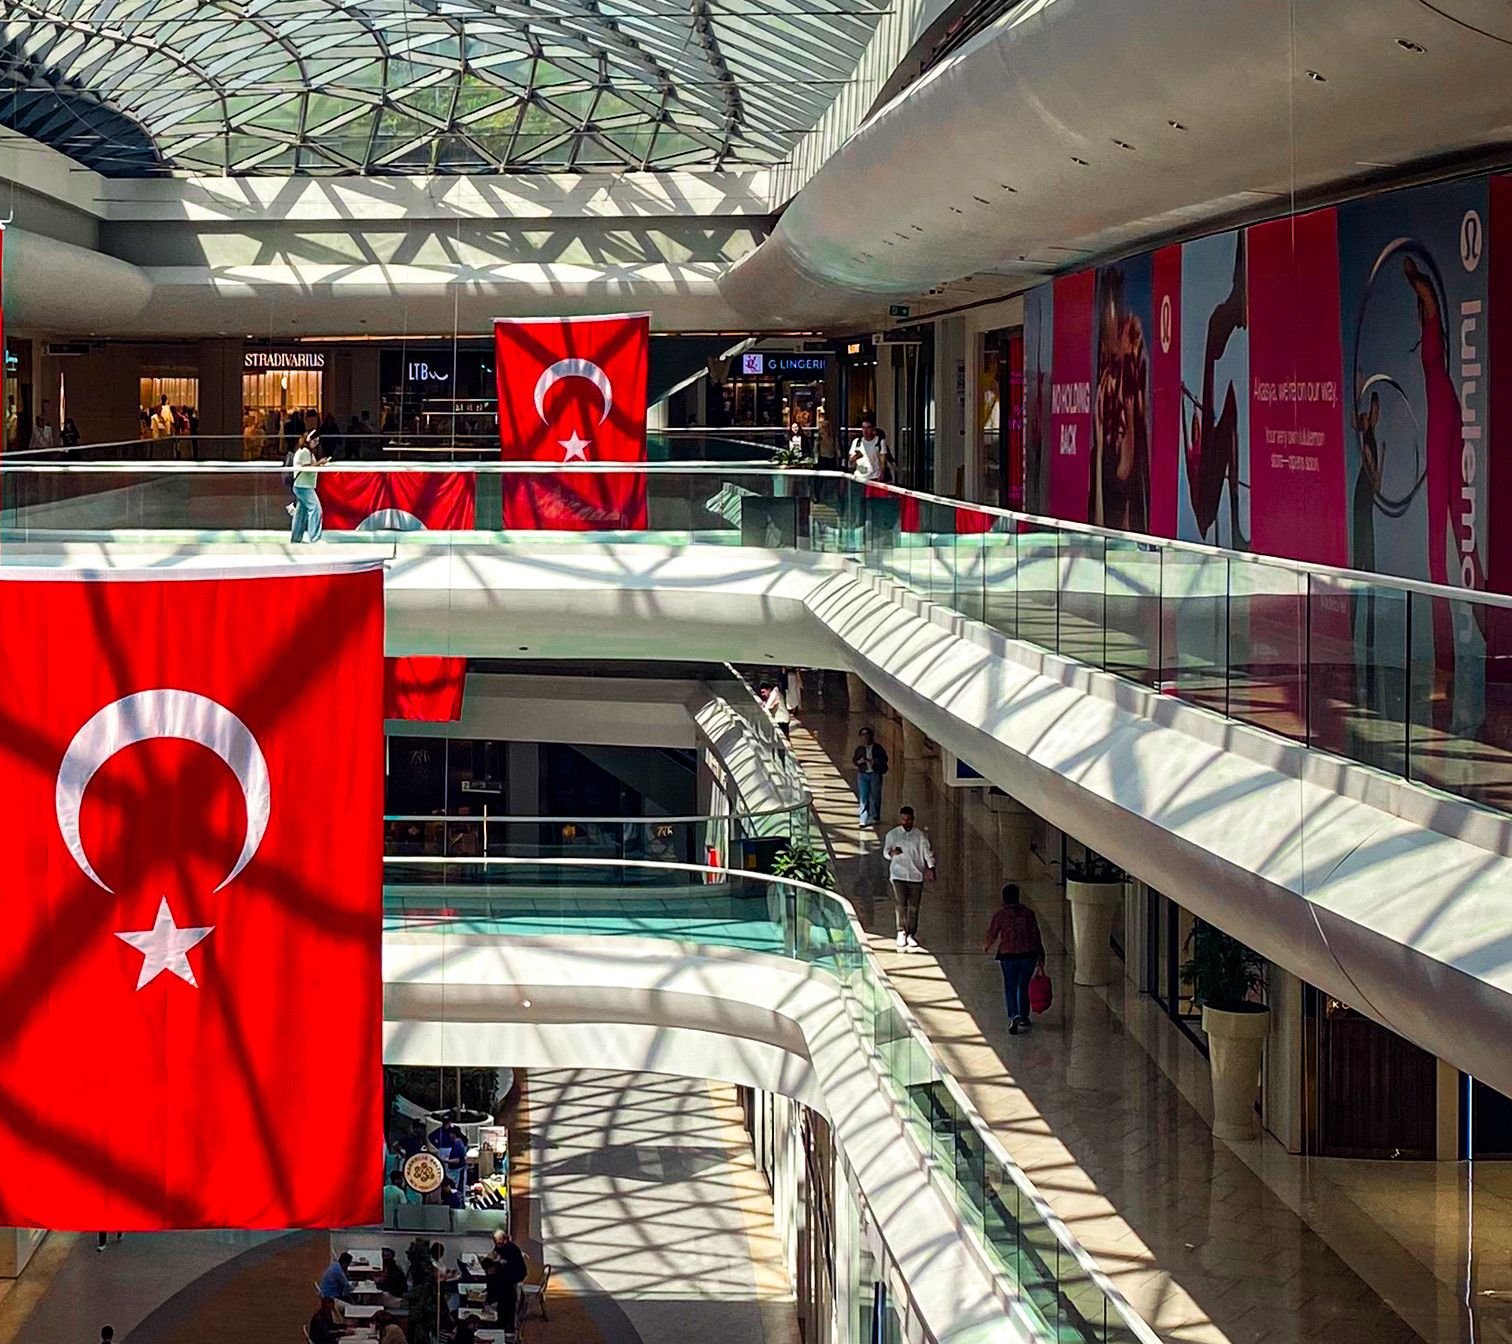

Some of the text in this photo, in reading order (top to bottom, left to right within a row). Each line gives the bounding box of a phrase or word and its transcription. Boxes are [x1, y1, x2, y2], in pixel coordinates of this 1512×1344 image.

[244, 352, 325, 368] STRADIVARIUS
[768, 359, 777, 369] G
[409, 362, 428, 381] LTB
[1460, 299, 1482, 644] lululemon
